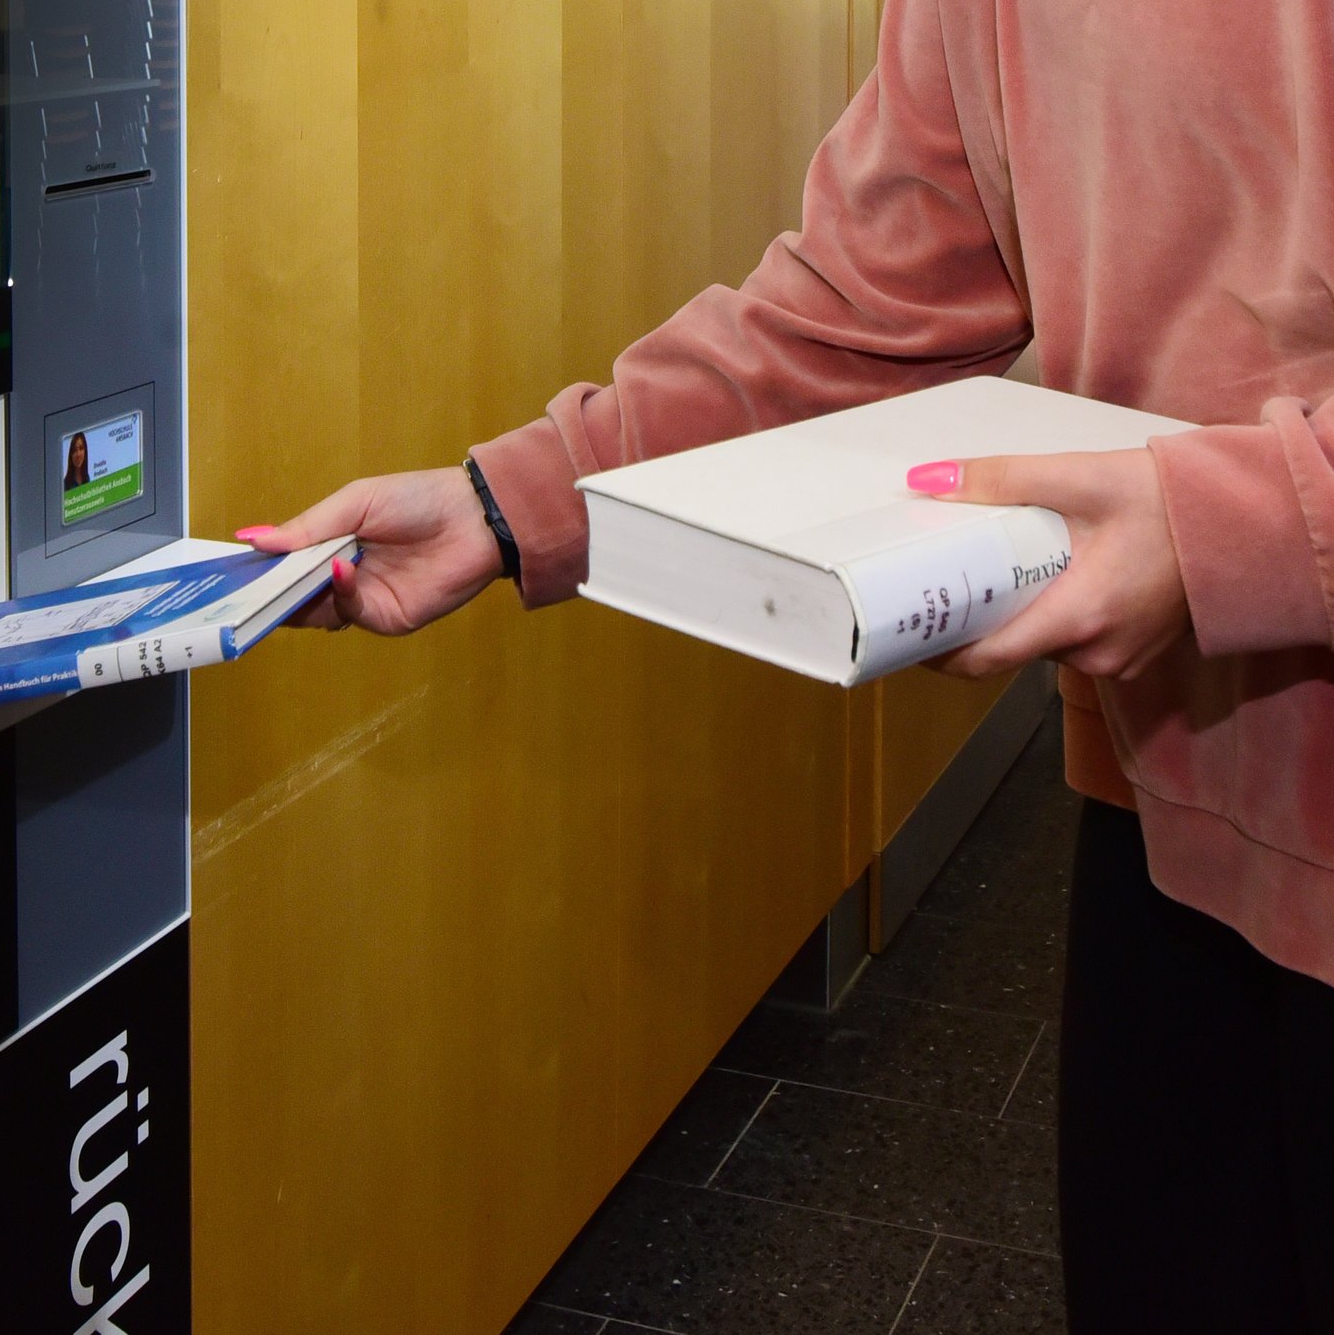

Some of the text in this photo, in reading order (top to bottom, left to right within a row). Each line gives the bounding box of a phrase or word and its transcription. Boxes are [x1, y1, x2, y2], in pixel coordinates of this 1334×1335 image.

[138, 641, 148, 661] 542
[153, 638, 163, 653] A2
[94, 663, 103, 676] 00
[4, 677, 40, 691] Handbuch
[41, 674, 52, 684] für
